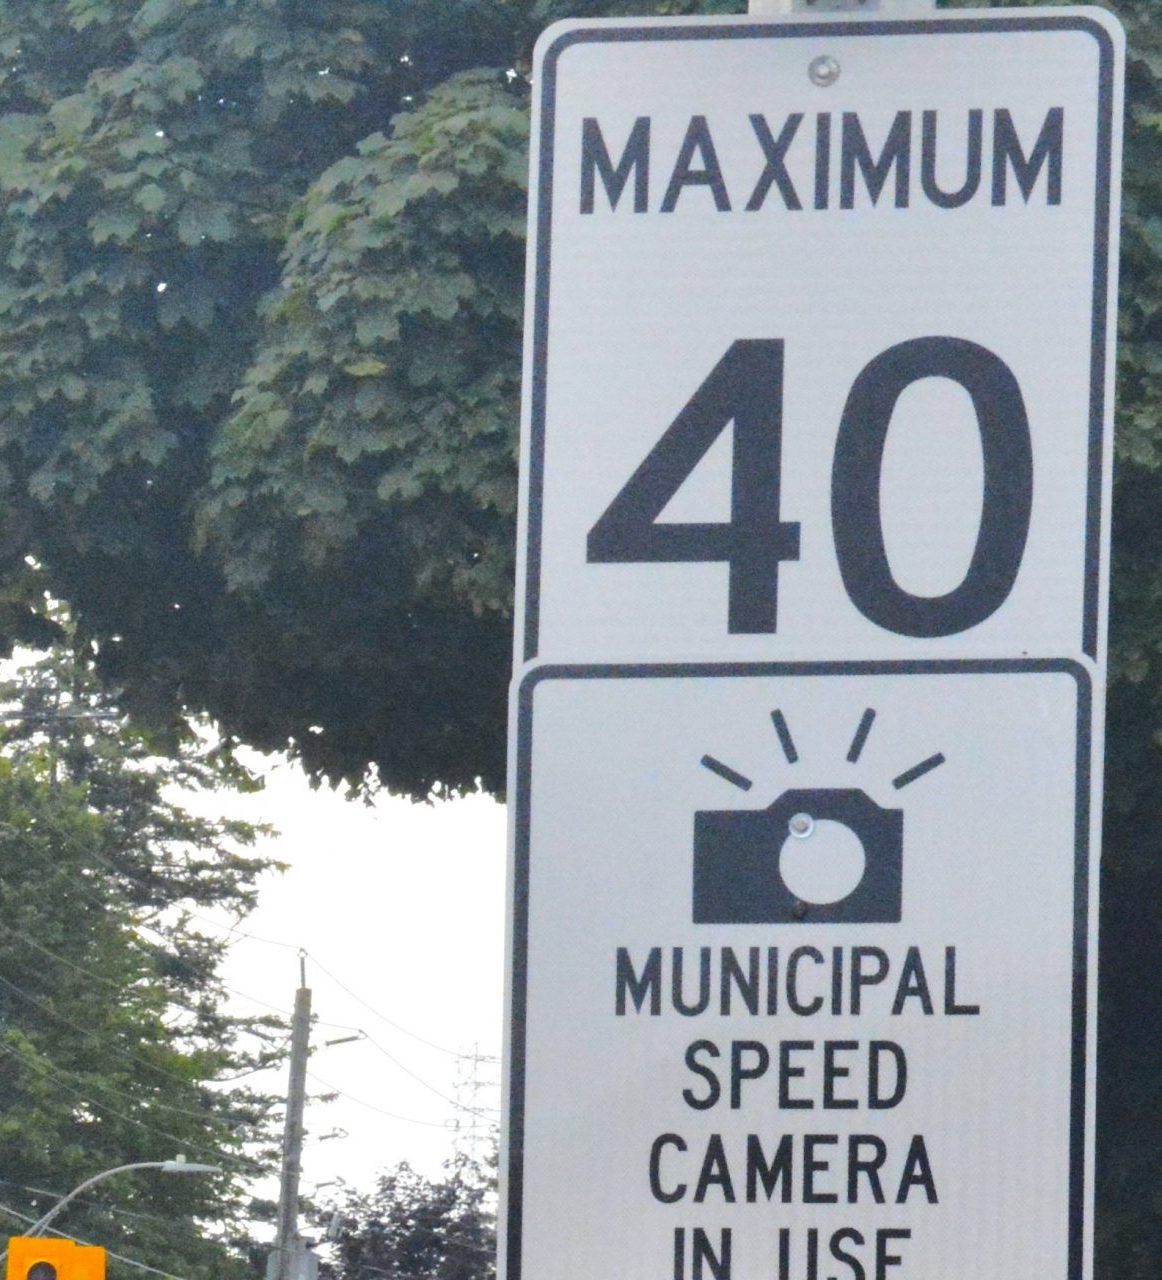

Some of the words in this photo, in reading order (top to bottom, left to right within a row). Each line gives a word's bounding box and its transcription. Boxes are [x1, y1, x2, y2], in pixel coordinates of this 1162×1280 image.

[580, 107, 1064, 214] MAXIMUM
[586, 335, 1034, 639] 40
[615, 945, 980, 1017] MUNICIPAL
[682, 1039, 908, 1111] SPEED
[648, 1132, 939, 1205] CAMERA
